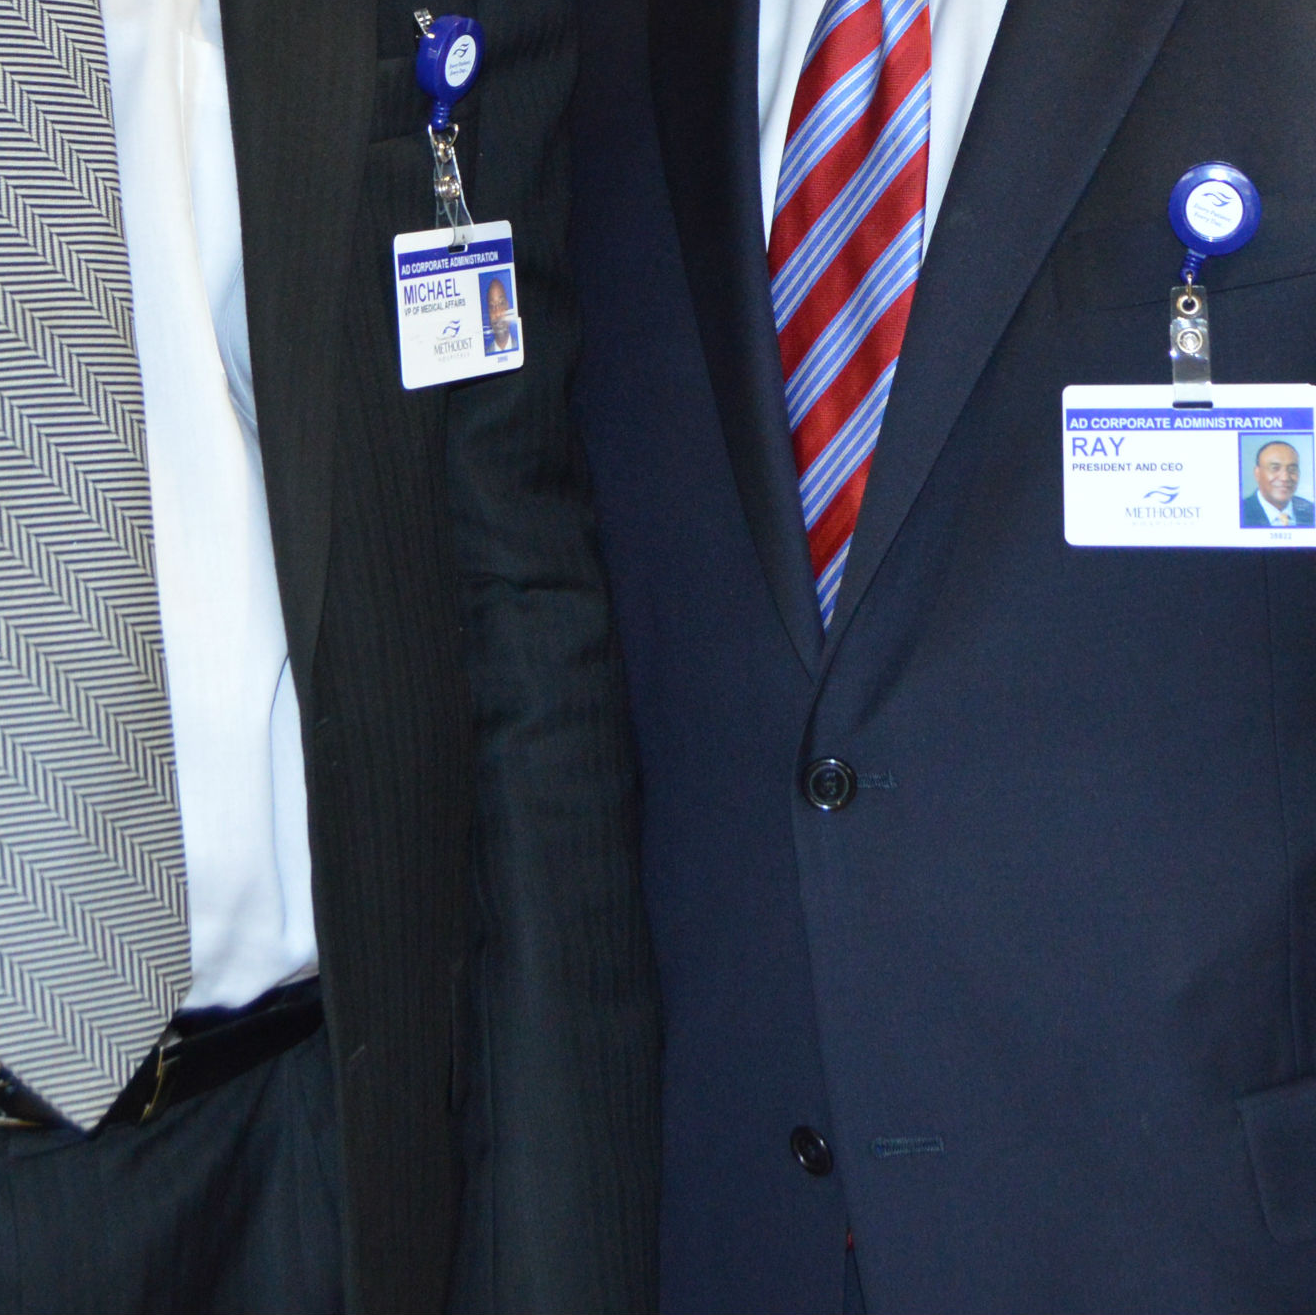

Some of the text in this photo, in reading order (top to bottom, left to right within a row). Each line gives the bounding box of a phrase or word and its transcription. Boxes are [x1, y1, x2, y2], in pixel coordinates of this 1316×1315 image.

[411, 258, 449, 274] CORPORATE
[450, 251, 499, 267] ADMINISTRATION
[404, 278, 460, 305] MICHAEL
[444, 298, 466, 310] AFFAIRS
[1069, 416, 1283, 429] AD CORPORATE ADMINISTRATION
[1072, 437, 1125, 456] RAY
[1072, 463, 1184, 472] PRESIDENT AND CEO
[1125, 506, 1201, 519] METHODIST
